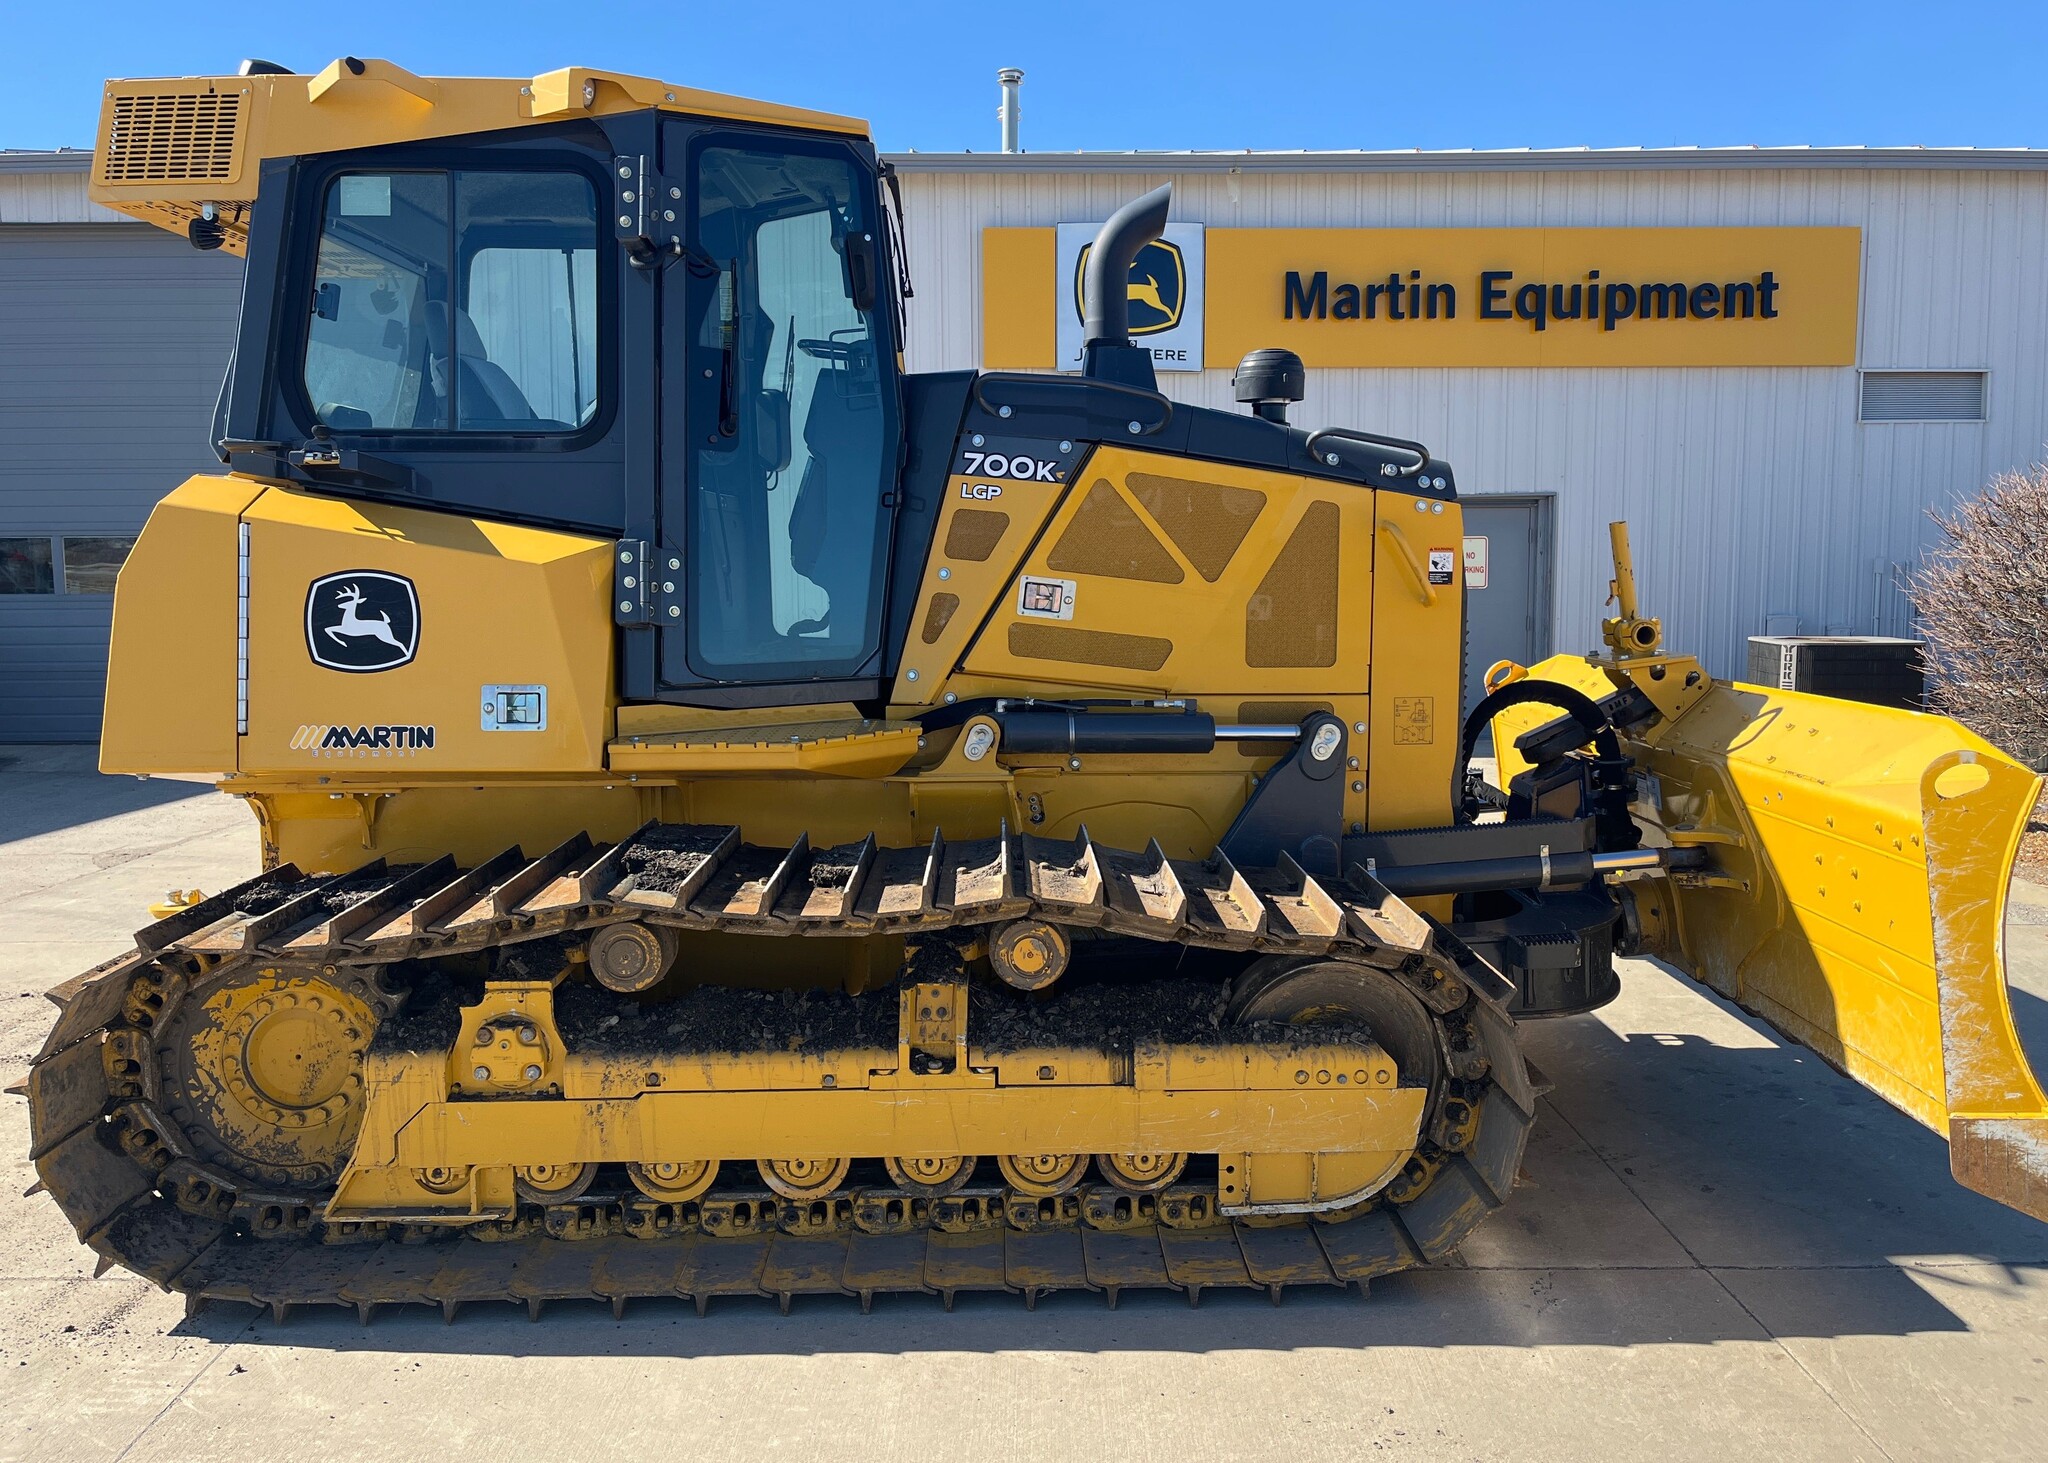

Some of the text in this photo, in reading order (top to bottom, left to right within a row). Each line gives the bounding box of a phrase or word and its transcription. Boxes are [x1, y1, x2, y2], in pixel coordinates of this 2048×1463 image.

[1284, 269, 1779, 331] Martin Equipment
[963, 451, 1058, 483] 700K
[961, 483, 1003, 501] LGP
[1782, 644, 1797, 680] YORK
[320, 725, 435, 749] MARTIN
[312, 750, 416, 758] Equipment
